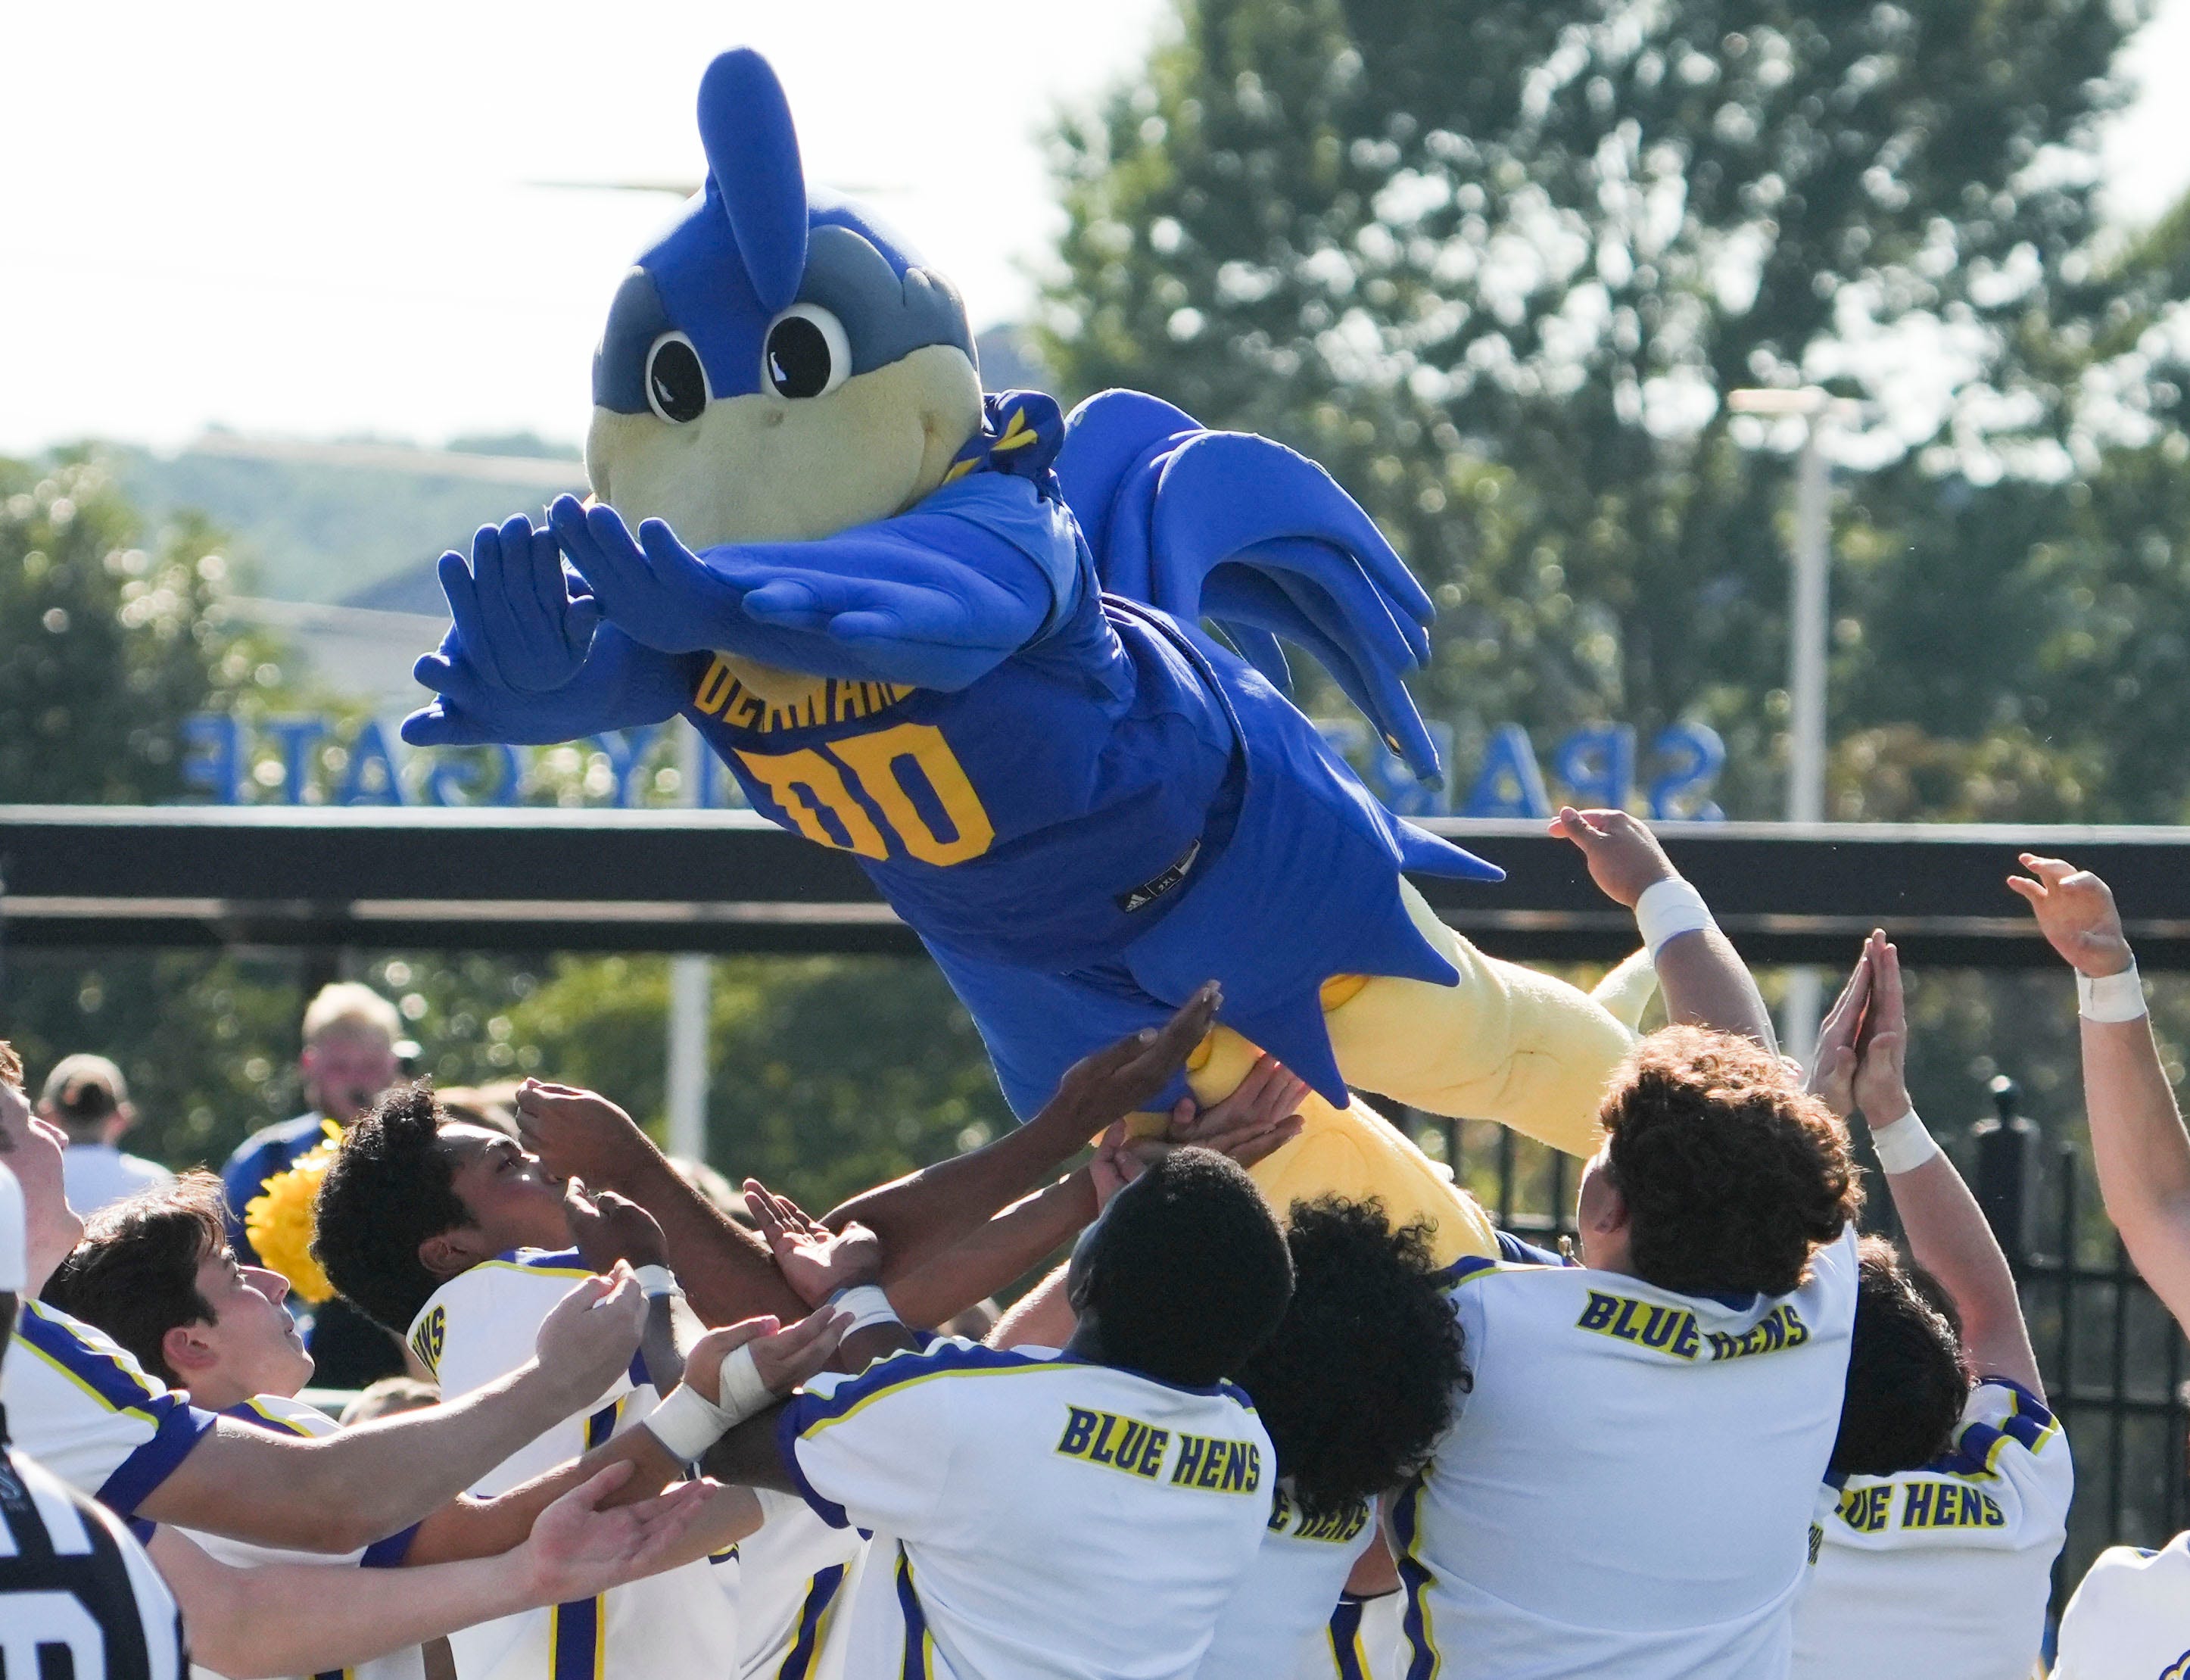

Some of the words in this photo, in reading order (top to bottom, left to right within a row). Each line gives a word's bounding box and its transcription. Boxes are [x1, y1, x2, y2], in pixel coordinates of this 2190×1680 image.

[693, 650, 916, 733] DEAWA
[731, 722, 996, 868] 00
[1576, 1289, 1701, 1360] BLUE
[1703, 1304, 1810, 1361] HENS
[1055, 1404, 1170, 1480] BLUE
[1170, 1432, 1262, 1493] HENS
[1833, 1483, 1895, 1533] UE
[1902, 1482, 2006, 1529] HENS
